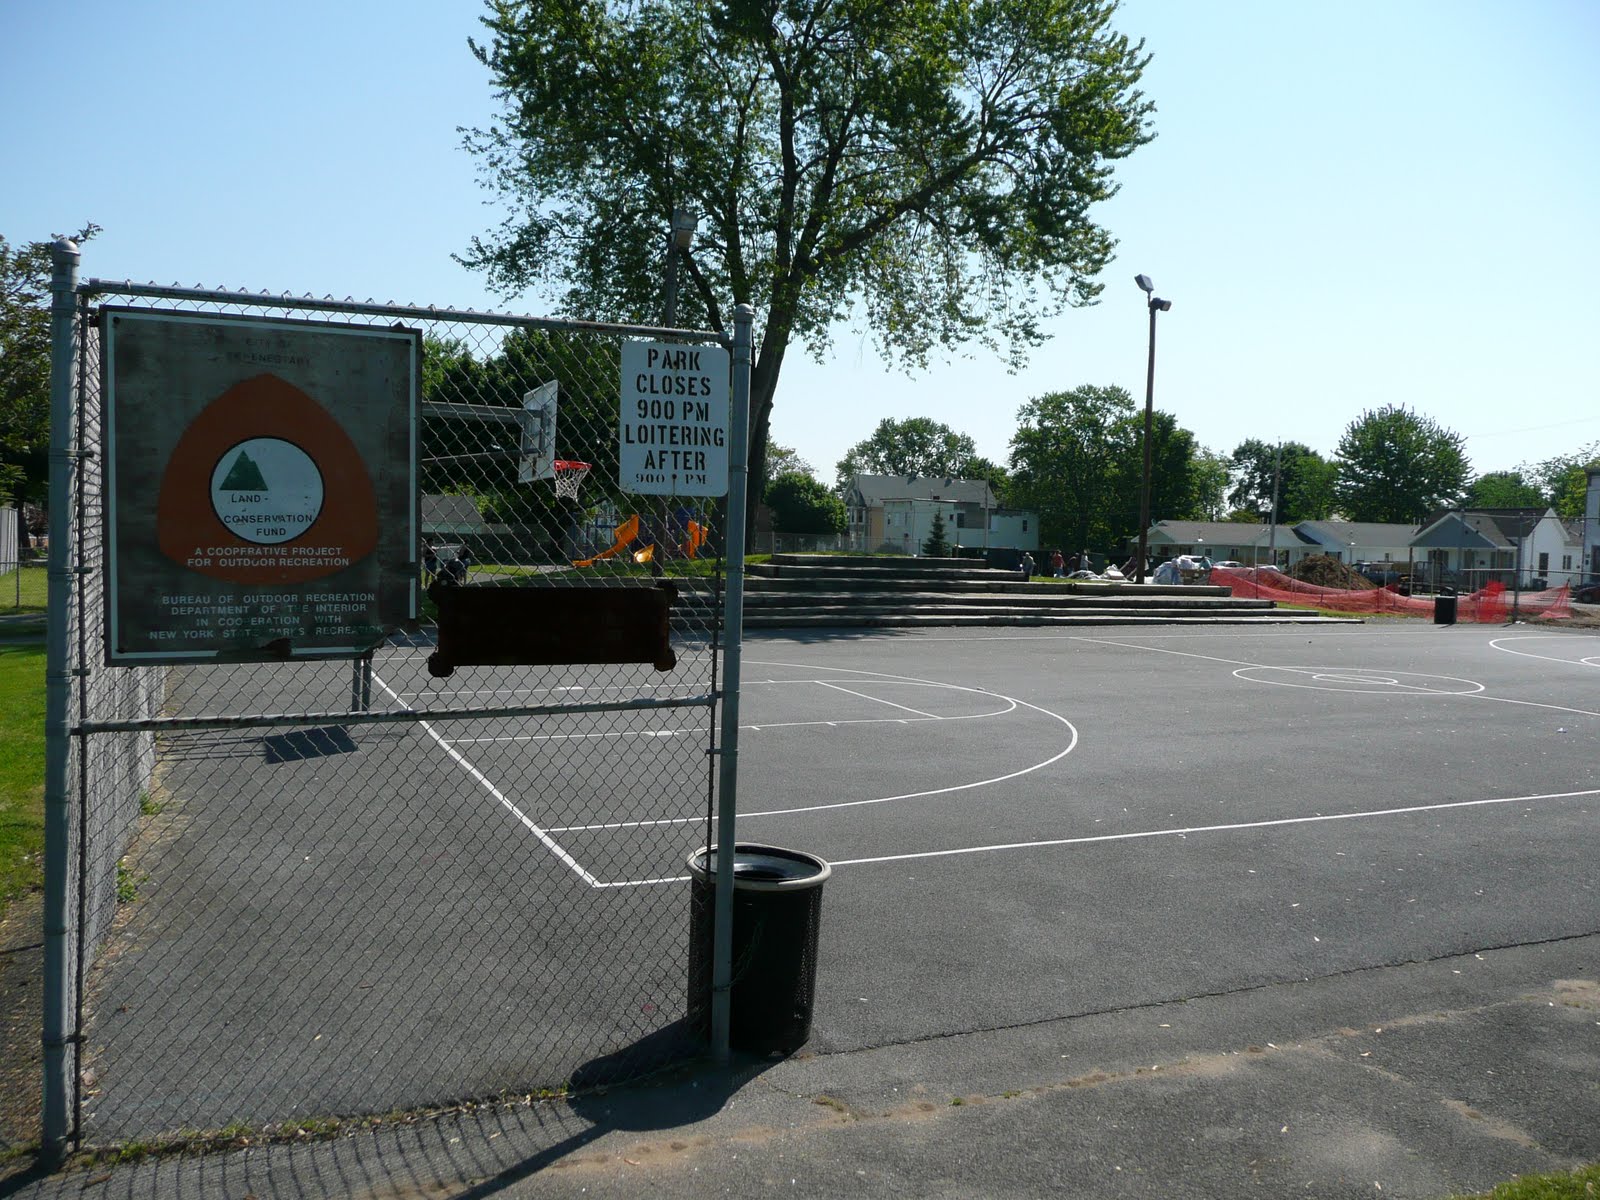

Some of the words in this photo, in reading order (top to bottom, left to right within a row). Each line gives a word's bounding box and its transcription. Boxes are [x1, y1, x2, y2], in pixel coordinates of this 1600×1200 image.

[647, 348, 701, 371] PARK
[636, 373, 711, 396] CLOSES
[637, 399, 675, 420] 900
[682, 401, 709, 422] PM
[625, 424, 724, 447] LOITERING
[644, 450, 706, 471] AFTER
[635, 473, 665, 484] 900
[685, 474, 707, 485] PM
[231, 493, 261, 503] LAND
[224, 514, 313, 524] CONSERVATION
[256, 528, 287, 537] FUND
[194, 547, 202, 556] A
[207, 547, 288, 556] COOPERATIVE
[292, 547, 342, 556] PROJECT
[187, 558, 211, 567] FOR
[219, 558, 276, 567] OUTDOOR
[279, 557, 350, 567] RECREATION
[162, 595, 211, 605] BUREAU
[218, 595, 234, 604] OF
[243, 594, 299, 604] OUTDOOR
[306, 593, 376, 602] RECREATION
[171, 606, 250, 615] DEPARTMENT
[261, 605, 276, 614] OF
[287, 604, 309, 613] TE
[316, 603, 367, 613] INTERIOR
[196, 618, 209, 626] IN
[218, 616, 300, 626] COOERATION
[314, 615, 342, 624] WITH
[149, 630, 177, 640] NEW
[183, 629, 214, 639] YORK
